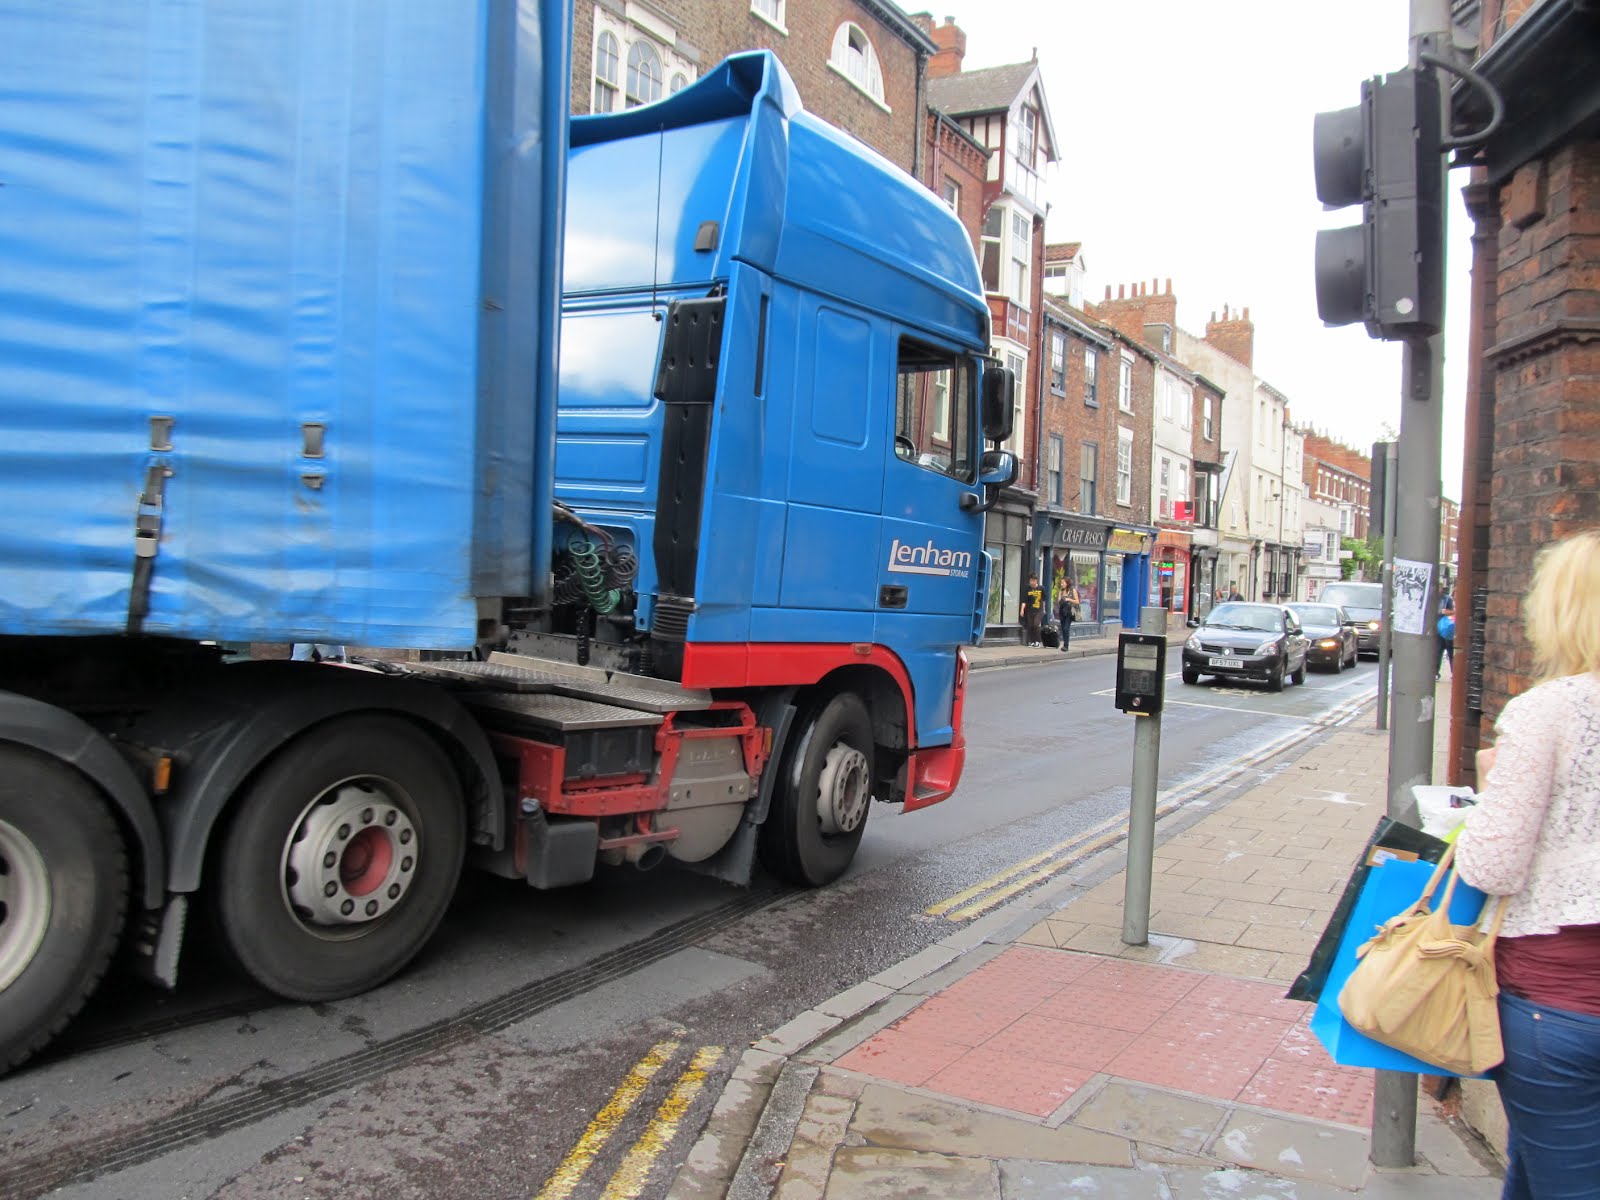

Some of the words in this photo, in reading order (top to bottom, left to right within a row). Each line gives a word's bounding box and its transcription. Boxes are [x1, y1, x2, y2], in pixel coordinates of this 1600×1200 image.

[1062, 528, 1084, 543] CRAFT
[1084, 531, 1104, 545] BASICS
[888, 539, 971, 576] Lenham
